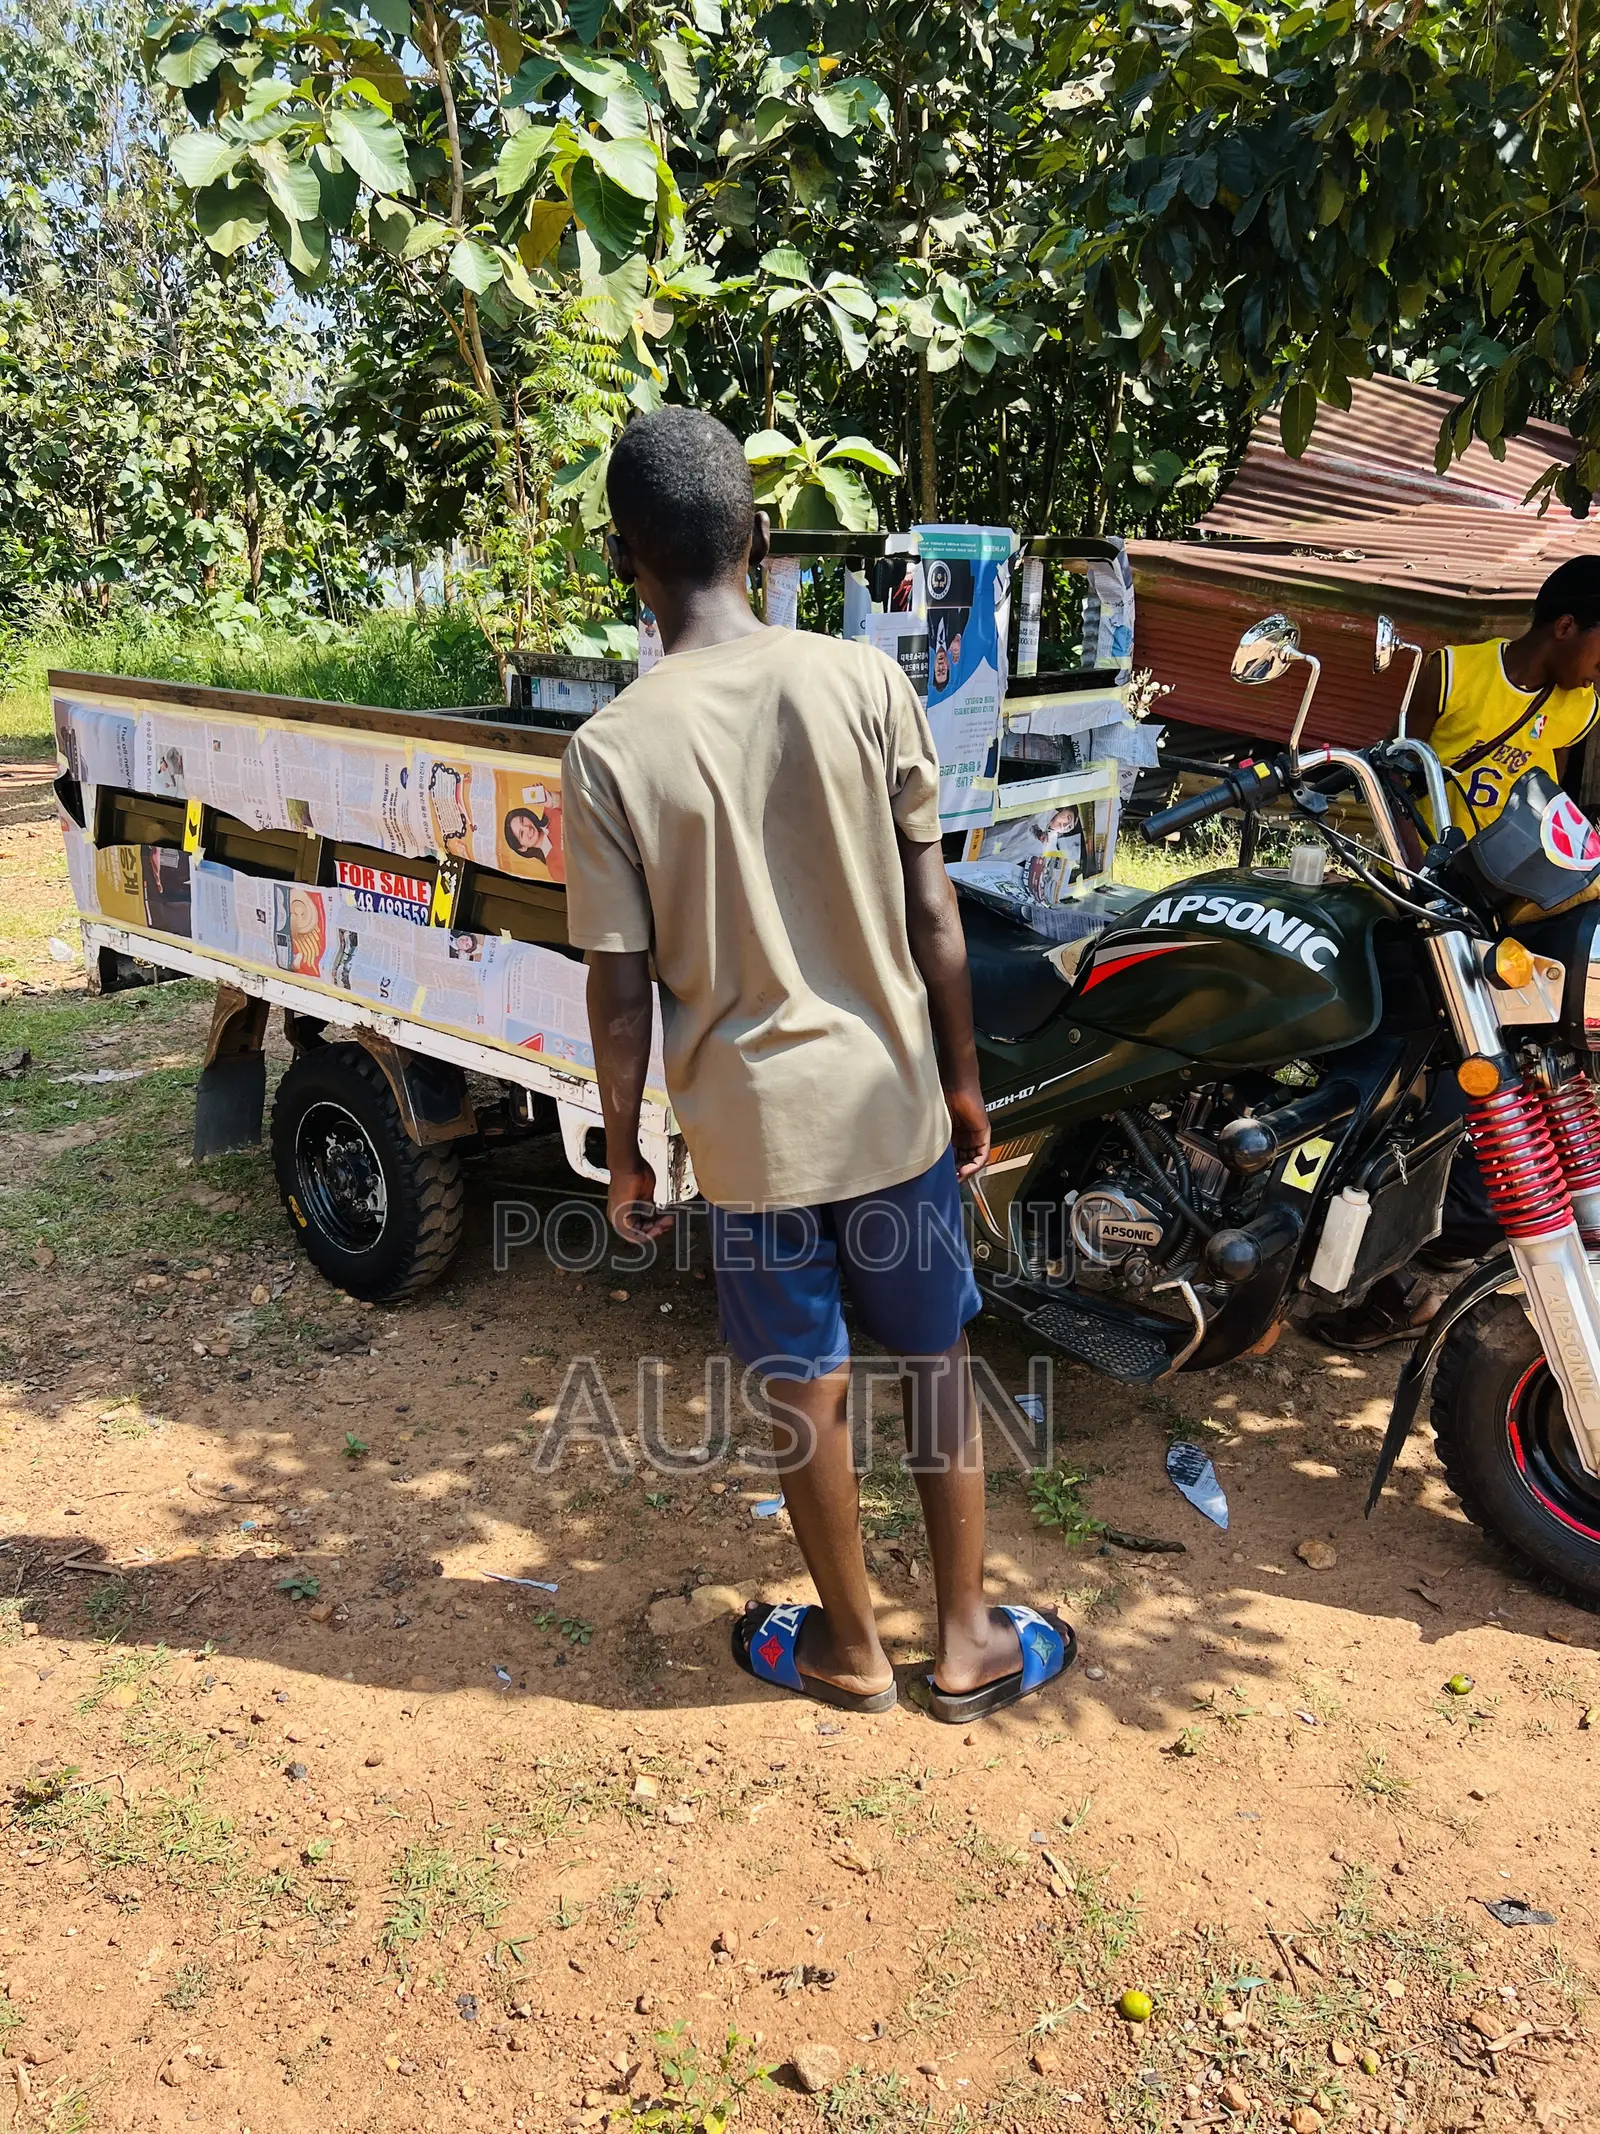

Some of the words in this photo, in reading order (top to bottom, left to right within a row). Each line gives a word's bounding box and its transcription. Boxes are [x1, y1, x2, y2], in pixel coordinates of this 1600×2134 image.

[1466, 766, 1504, 808] 6
[338, 861, 375, 891] FOR
[380, 871, 428, 904] SALE
[1141, 895, 1340, 973] APSONIC
[1102, 1225, 1154, 1241] APSONIC
[1545, 1290, 1600, 1405] APSONIC
